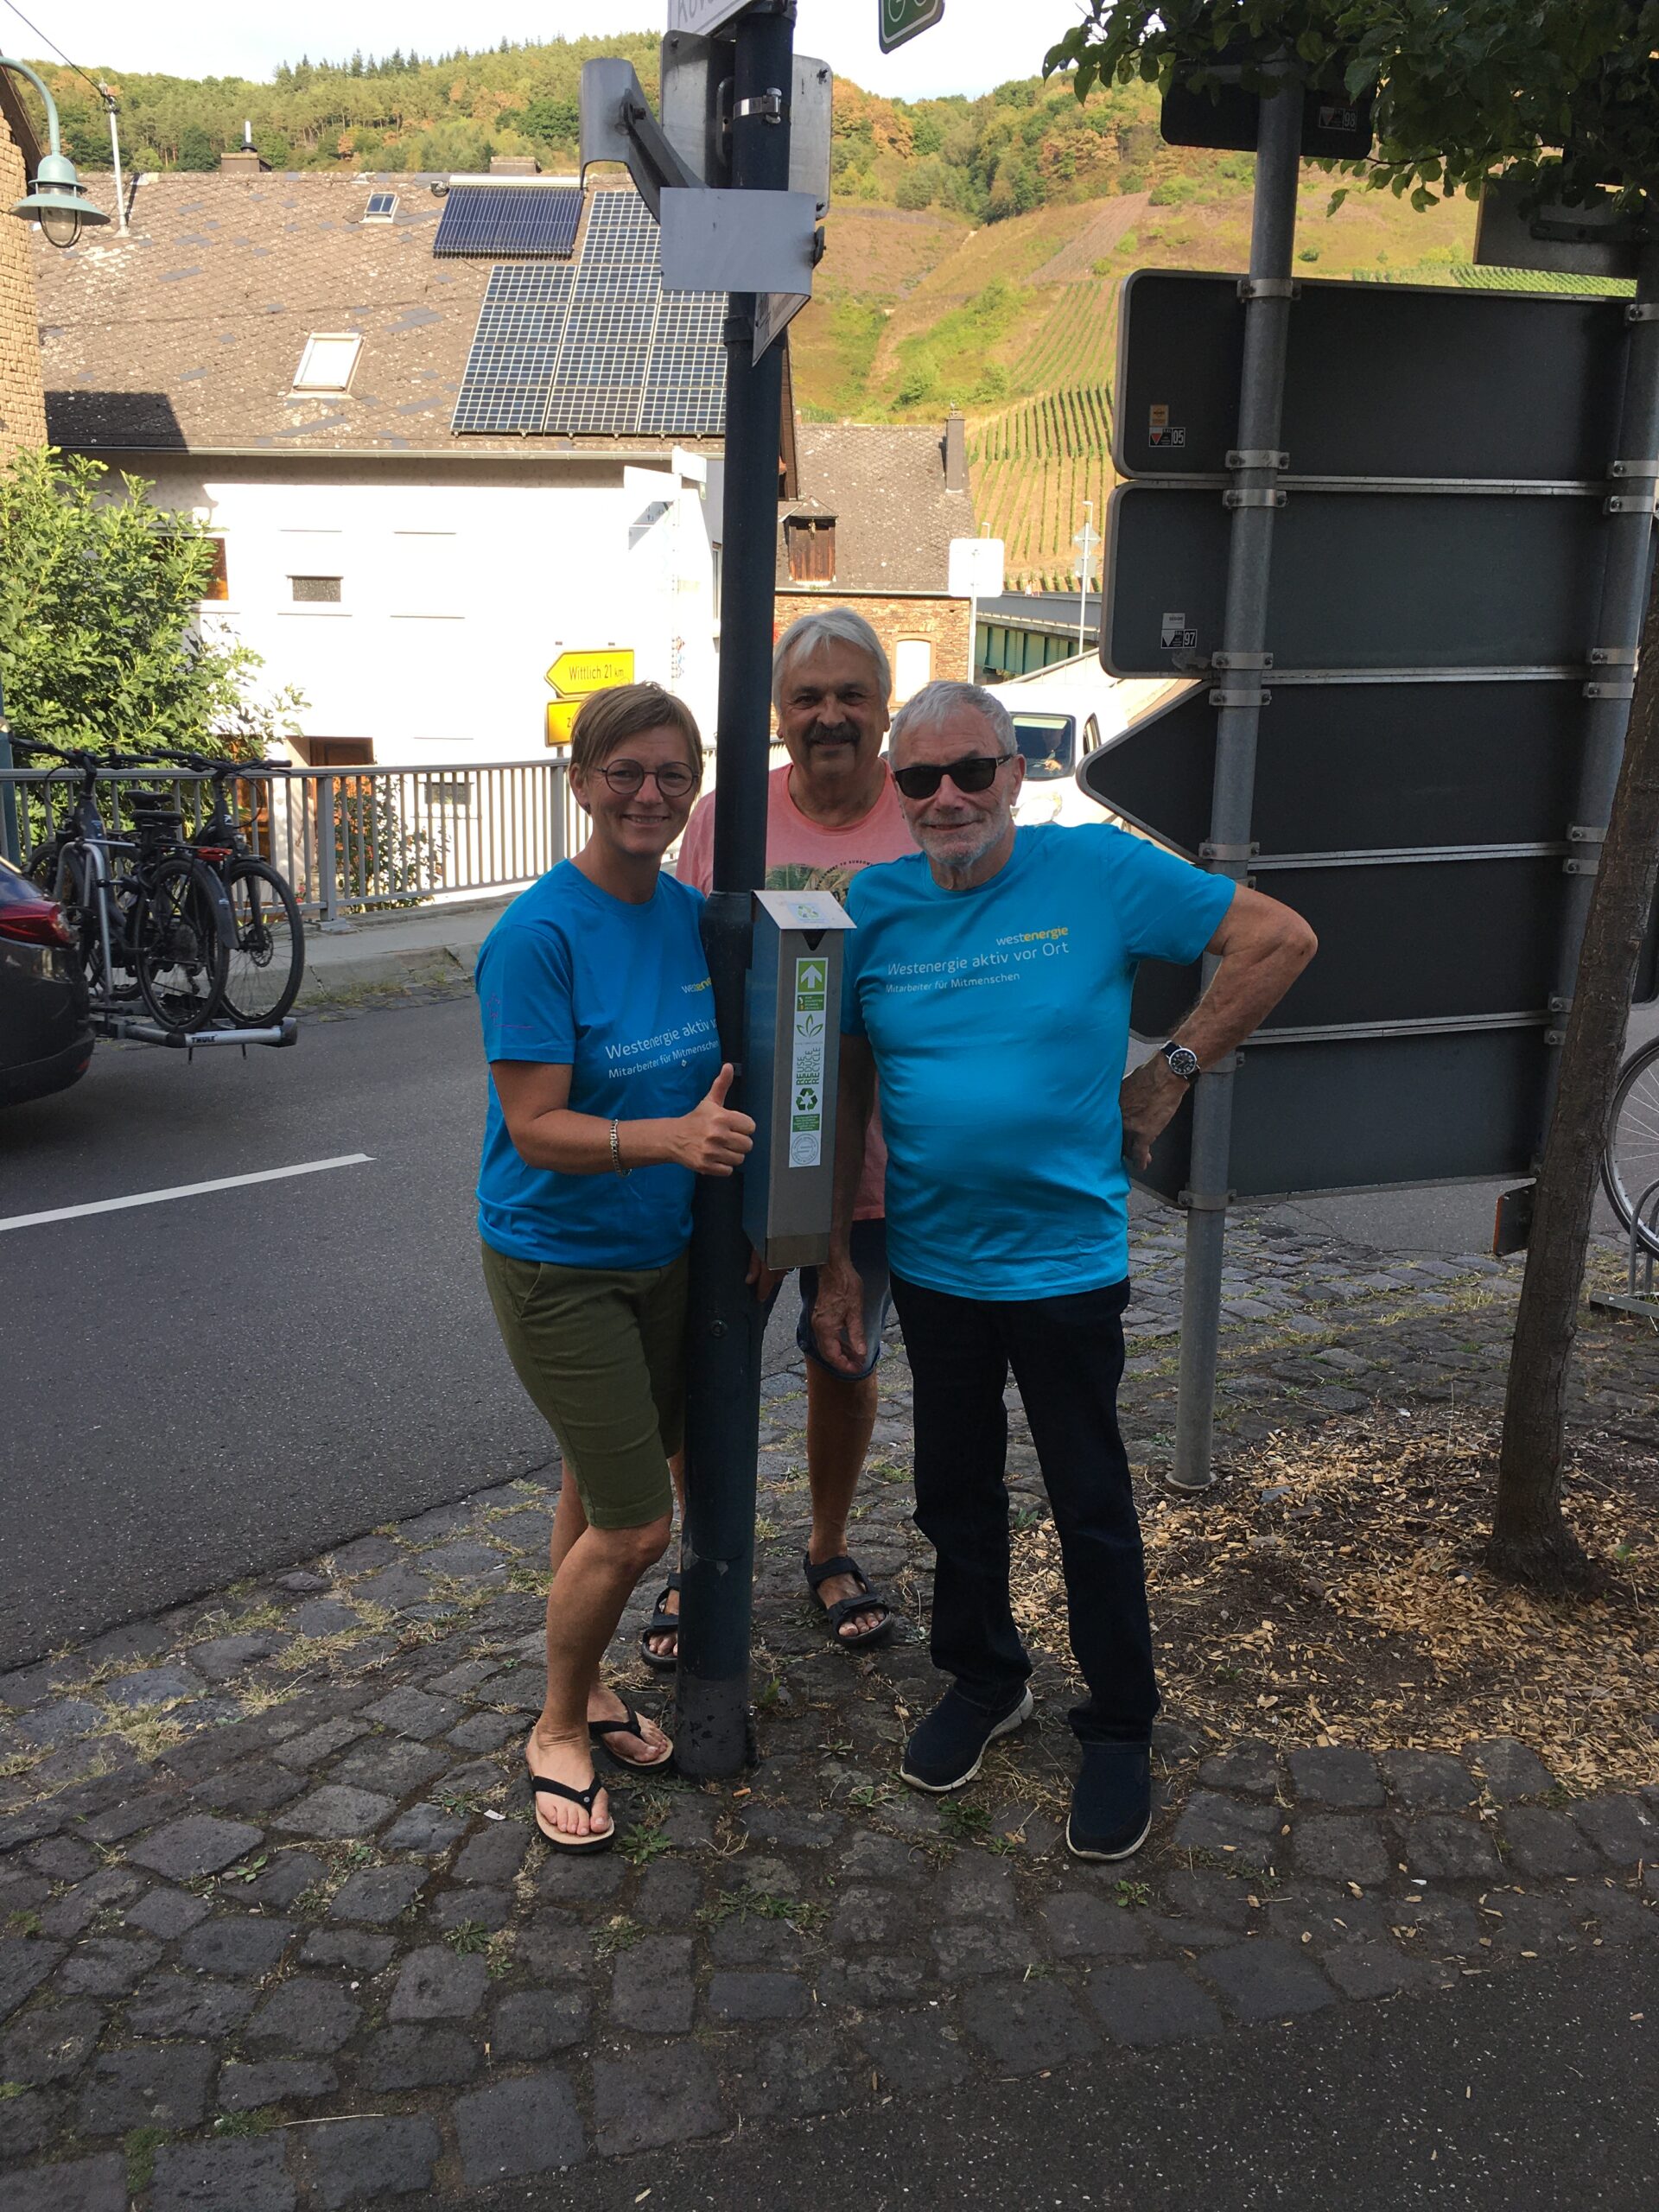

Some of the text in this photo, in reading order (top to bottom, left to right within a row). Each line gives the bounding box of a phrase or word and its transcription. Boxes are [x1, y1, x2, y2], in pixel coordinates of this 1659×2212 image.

[1173, 429, 1184, 444] 05
[1185, 632, 1196, 645] 97
[569, 664, 624, 681] Wittlich 21 km
[996, 926, 1069, 946] westenergie
[887, 942, 1070, 976] Westenergie aktiv vor Ort
[886, 973, 1020, 994] Mitarbeiter für Mitmenschen
[605, 1028, 681, 1060] Westenergie
[682, 1019, 709, 1037] aktiv
[608, 1039, 719, 1079] Mitarbeiter für Mitmenschen
[796, 1057, 804, 1085] REUSE
[804, 1050, 812, 1085] REDUCE
[811, 1046, 821, 1084] RECYCLE
